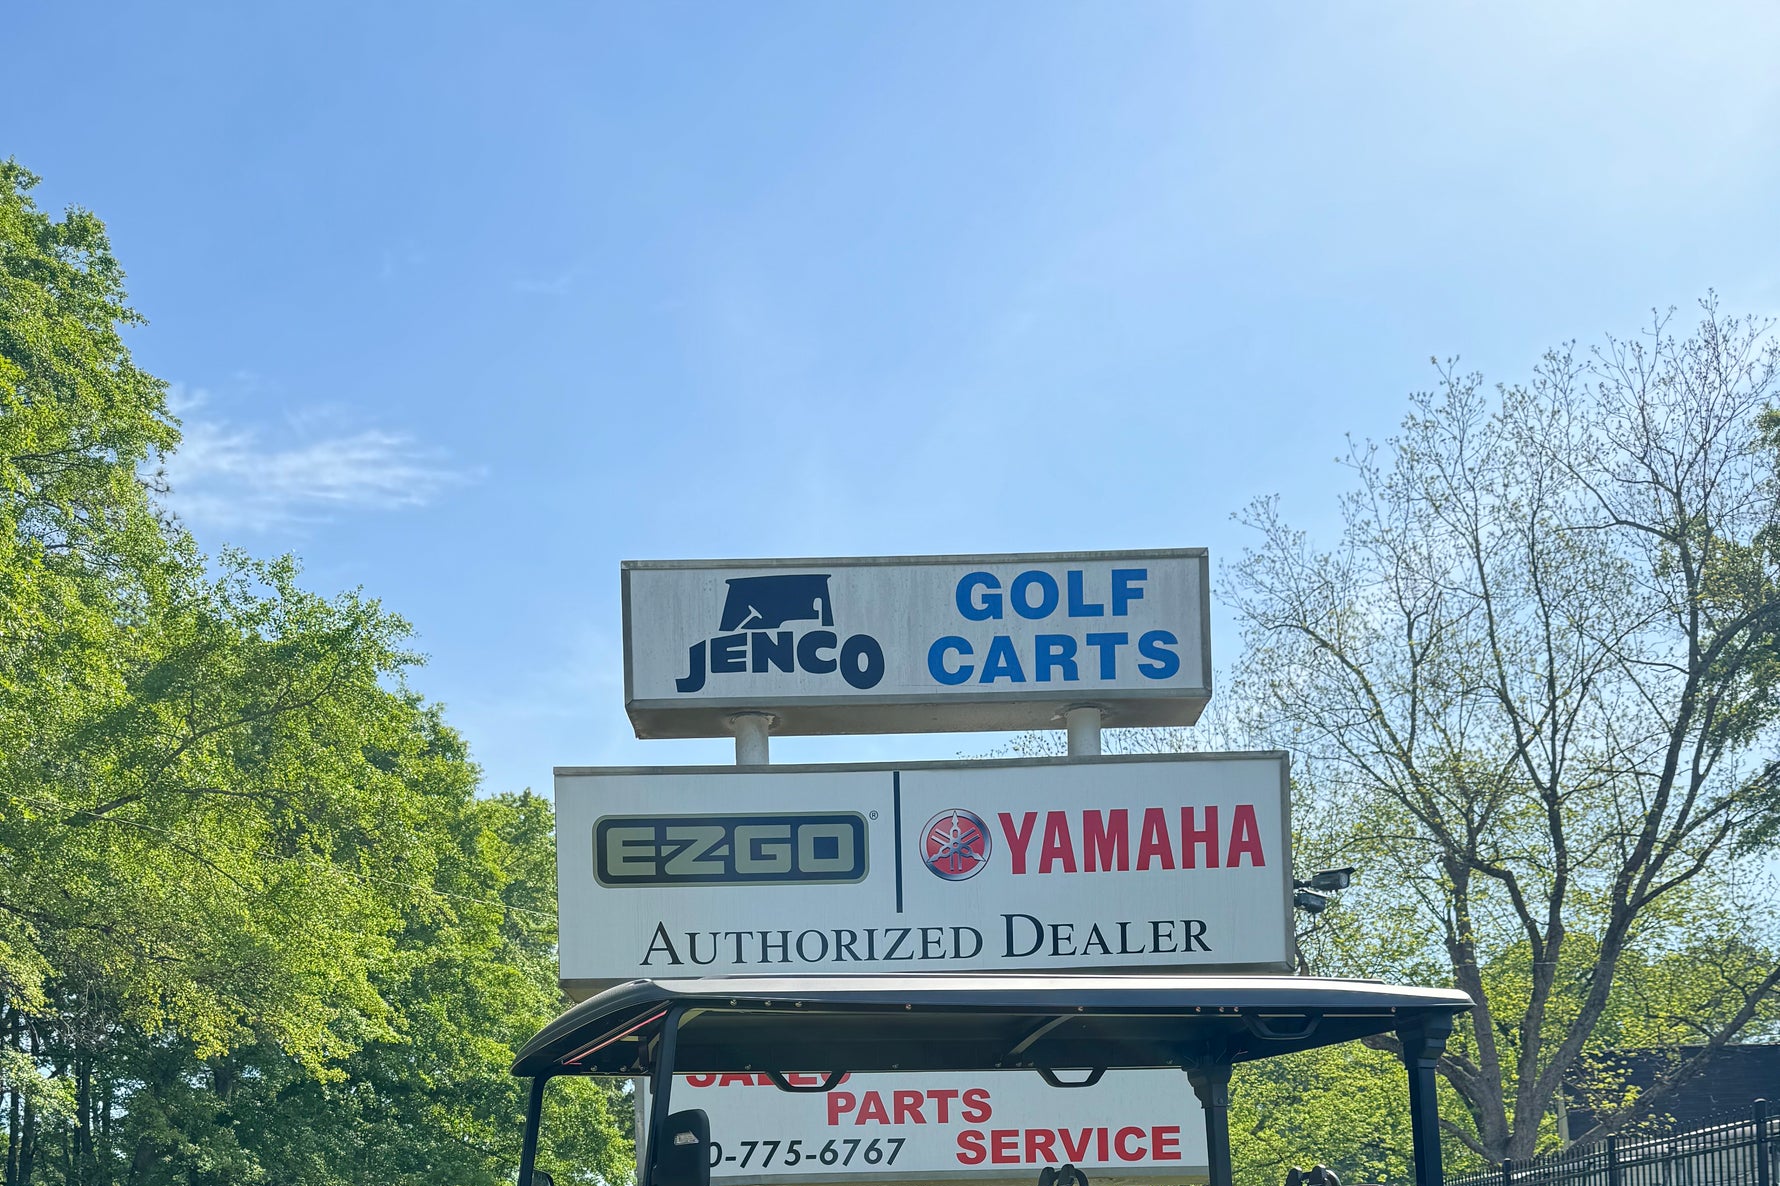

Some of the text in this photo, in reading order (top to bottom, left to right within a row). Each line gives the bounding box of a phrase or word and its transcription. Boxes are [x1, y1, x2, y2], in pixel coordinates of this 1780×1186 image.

[955, 568, 1148, 621] GOLF
[675, 630, 885, 693] JENCO
[927, 630, 1180, 686] CARTS
[998, 804, 1266, 875] YAMAHA
[827, 1089, 992, 1126] PARTS
[956, 1126, 1181, 1165] SERVICE
